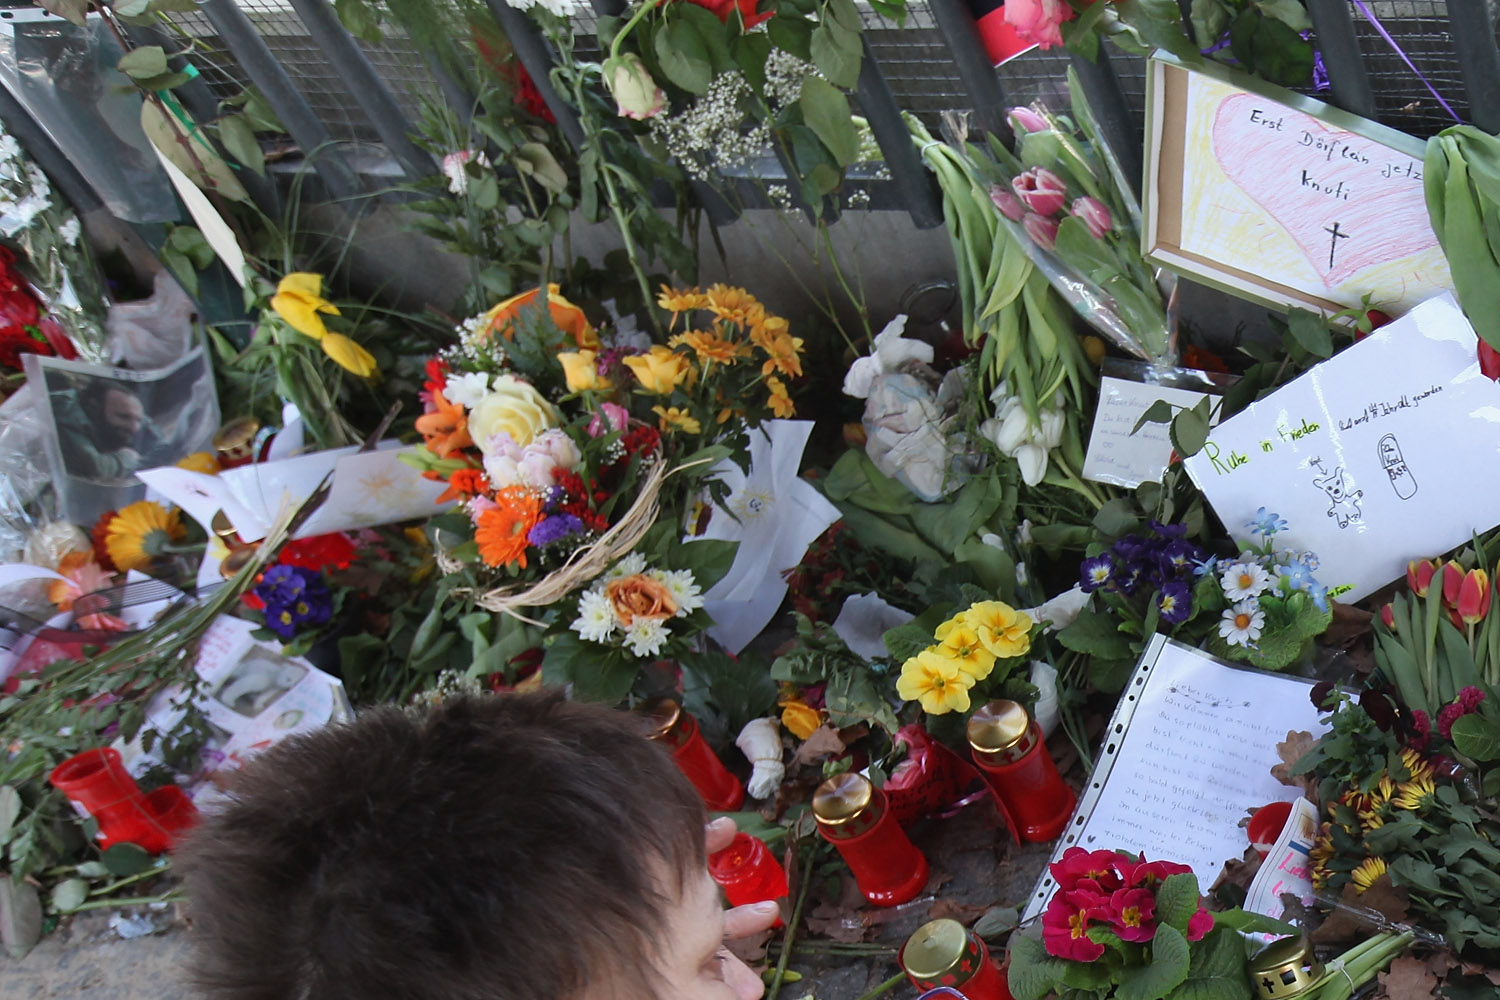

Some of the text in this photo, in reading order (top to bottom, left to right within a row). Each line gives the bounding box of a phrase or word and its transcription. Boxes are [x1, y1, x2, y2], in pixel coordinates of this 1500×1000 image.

[1250, 109, 1283, 132] Erst
[1381, 162, 1423, 181] jetz
[1260, 440, 1273, 453] in
[1277, 418, 1320, 443] Frieden
